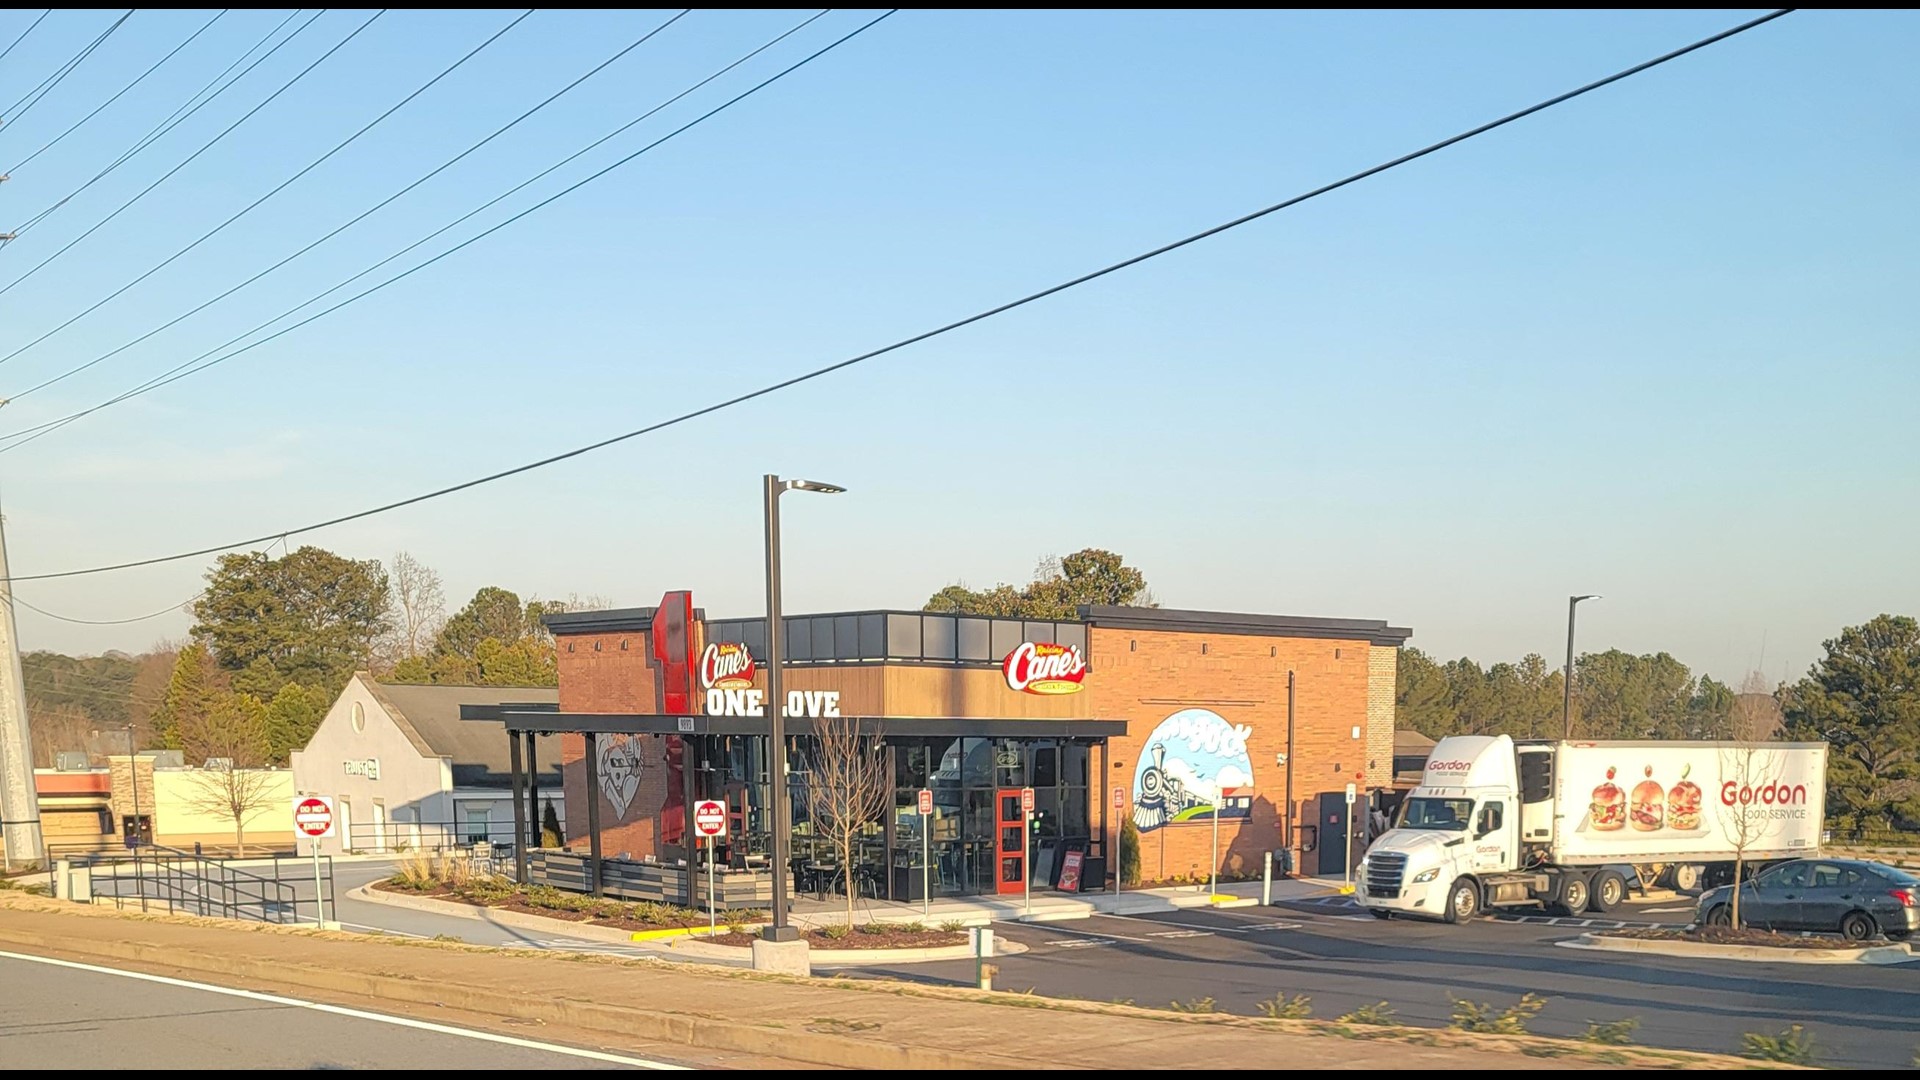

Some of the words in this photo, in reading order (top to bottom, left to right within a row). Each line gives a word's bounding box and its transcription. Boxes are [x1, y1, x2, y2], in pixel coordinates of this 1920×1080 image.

[1036, 645, 1064, 656] Raising
[702, 642, 753, 689] Cane's
[1008, 642, 1086, 690] Cane's
[706, 689, 764, 717] ONE
[782, 690, 840, 718] OVE
[1429, 760, 1471, 770] Gordon
[1721, 780, 1806, 806] Gordon
[300, 805, 311, 813] DO
[312, 805, 326, 813] NOT
[1745, 809, 1767, 819] OOD
[1768, 809, 1806, 819] SERVICE
